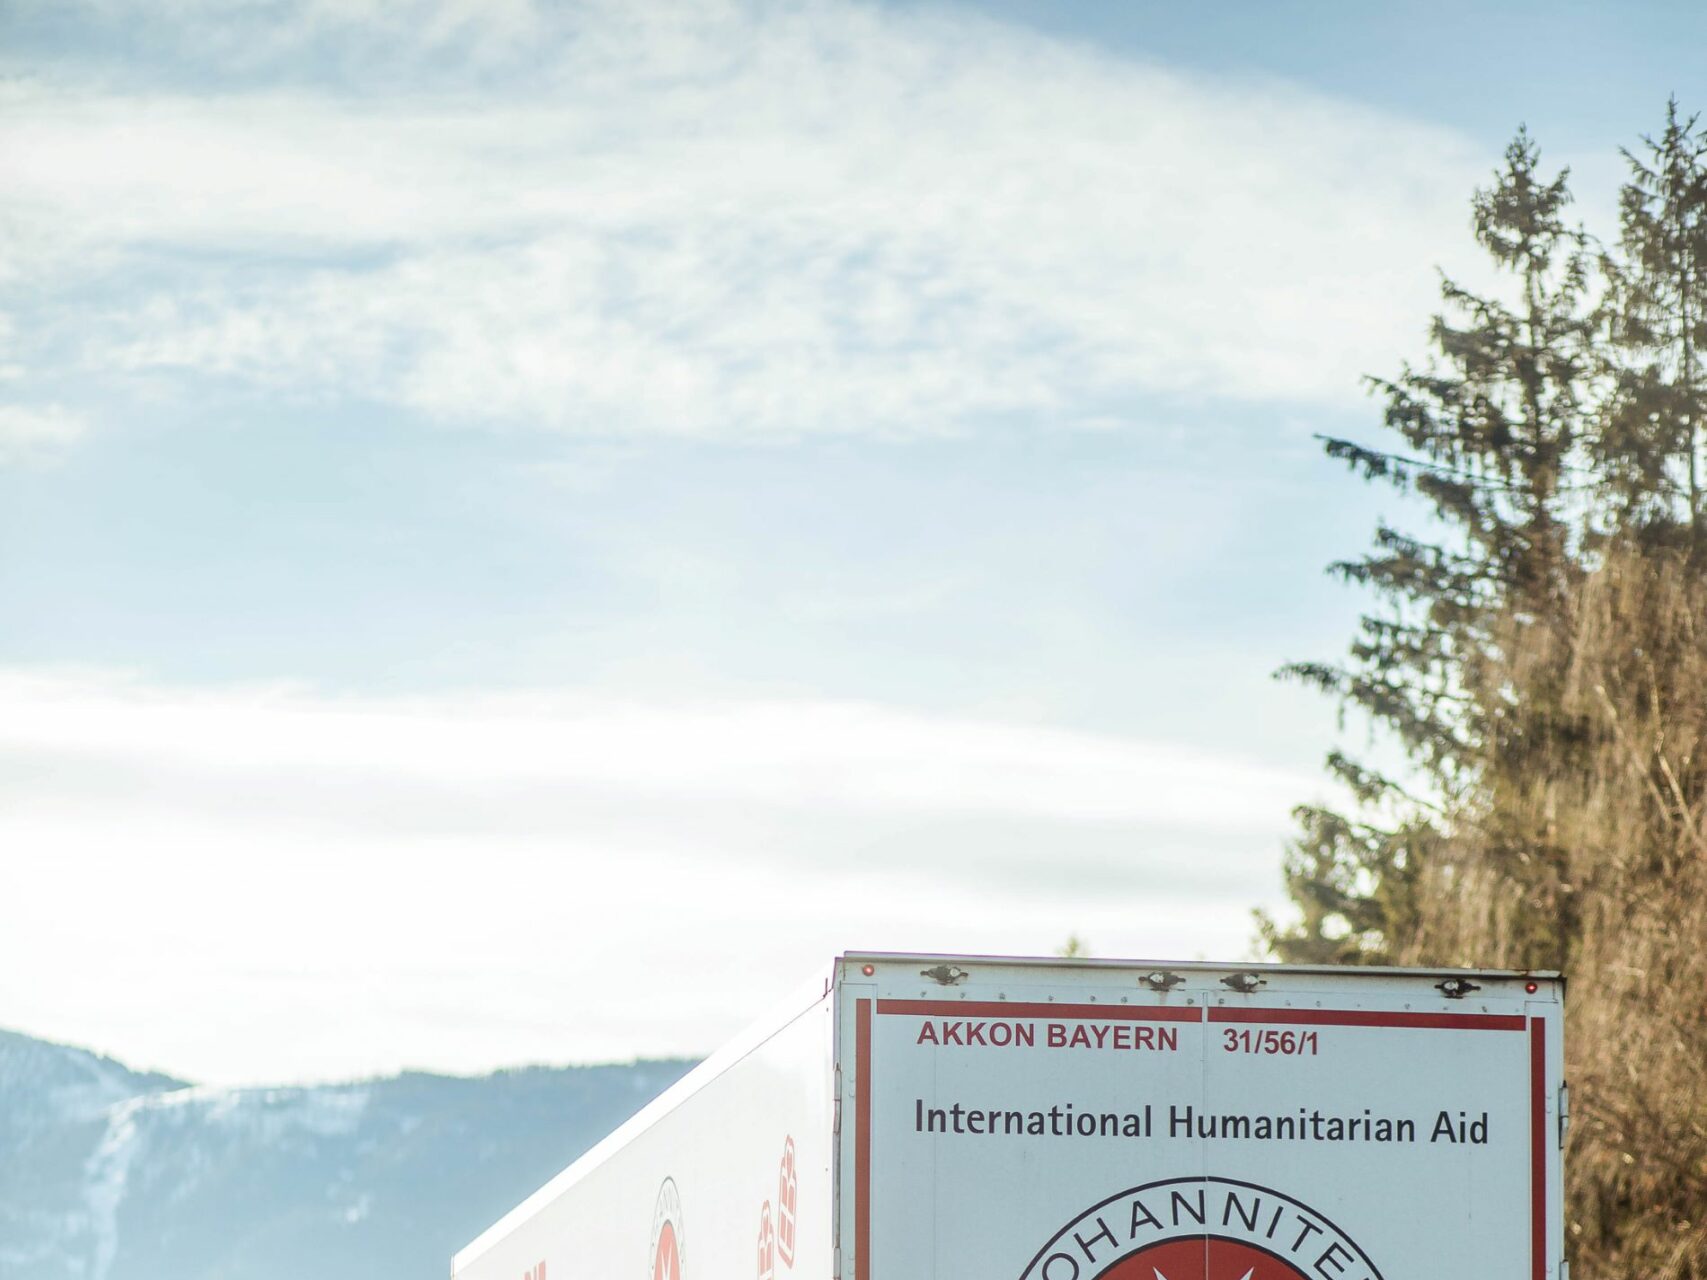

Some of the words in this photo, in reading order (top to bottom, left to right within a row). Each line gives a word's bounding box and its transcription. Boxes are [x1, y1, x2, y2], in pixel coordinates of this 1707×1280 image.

[916, 1021, 1035, 1048] AKKON
[1047, 1024, 1178, 1052] BAYERN
[1223, 1028, 1319, 1056] 31/56/1
[915, 1099, 1153, 1138] International
[1169, 1105, 1416, 1143] Humanitarian
[1430, 1110, 1490, 1145] Aid
